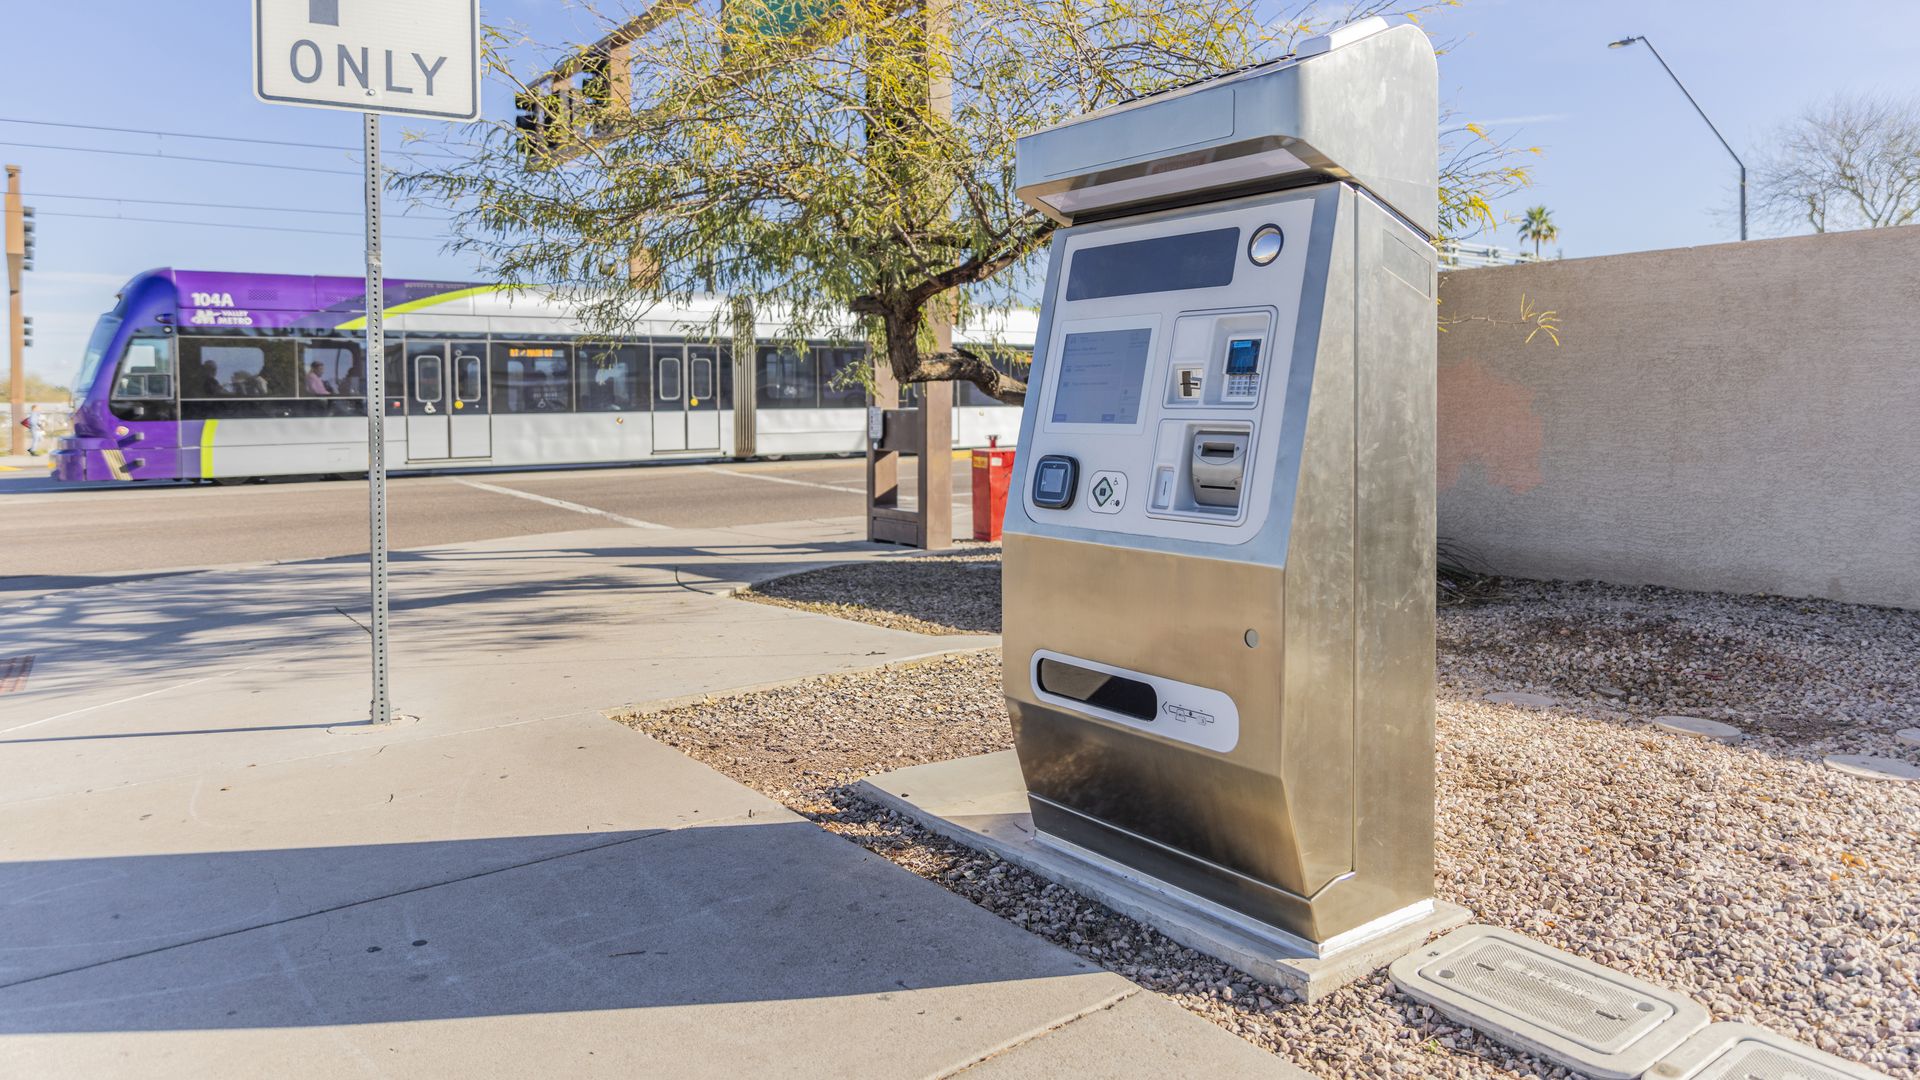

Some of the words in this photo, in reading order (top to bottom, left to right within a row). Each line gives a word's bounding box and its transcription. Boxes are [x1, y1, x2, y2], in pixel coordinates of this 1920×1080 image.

[290, 39, 448, 96] ONLY
[191, 292, 235, 307] 104A
[216, 317, 253, 325] METRO
